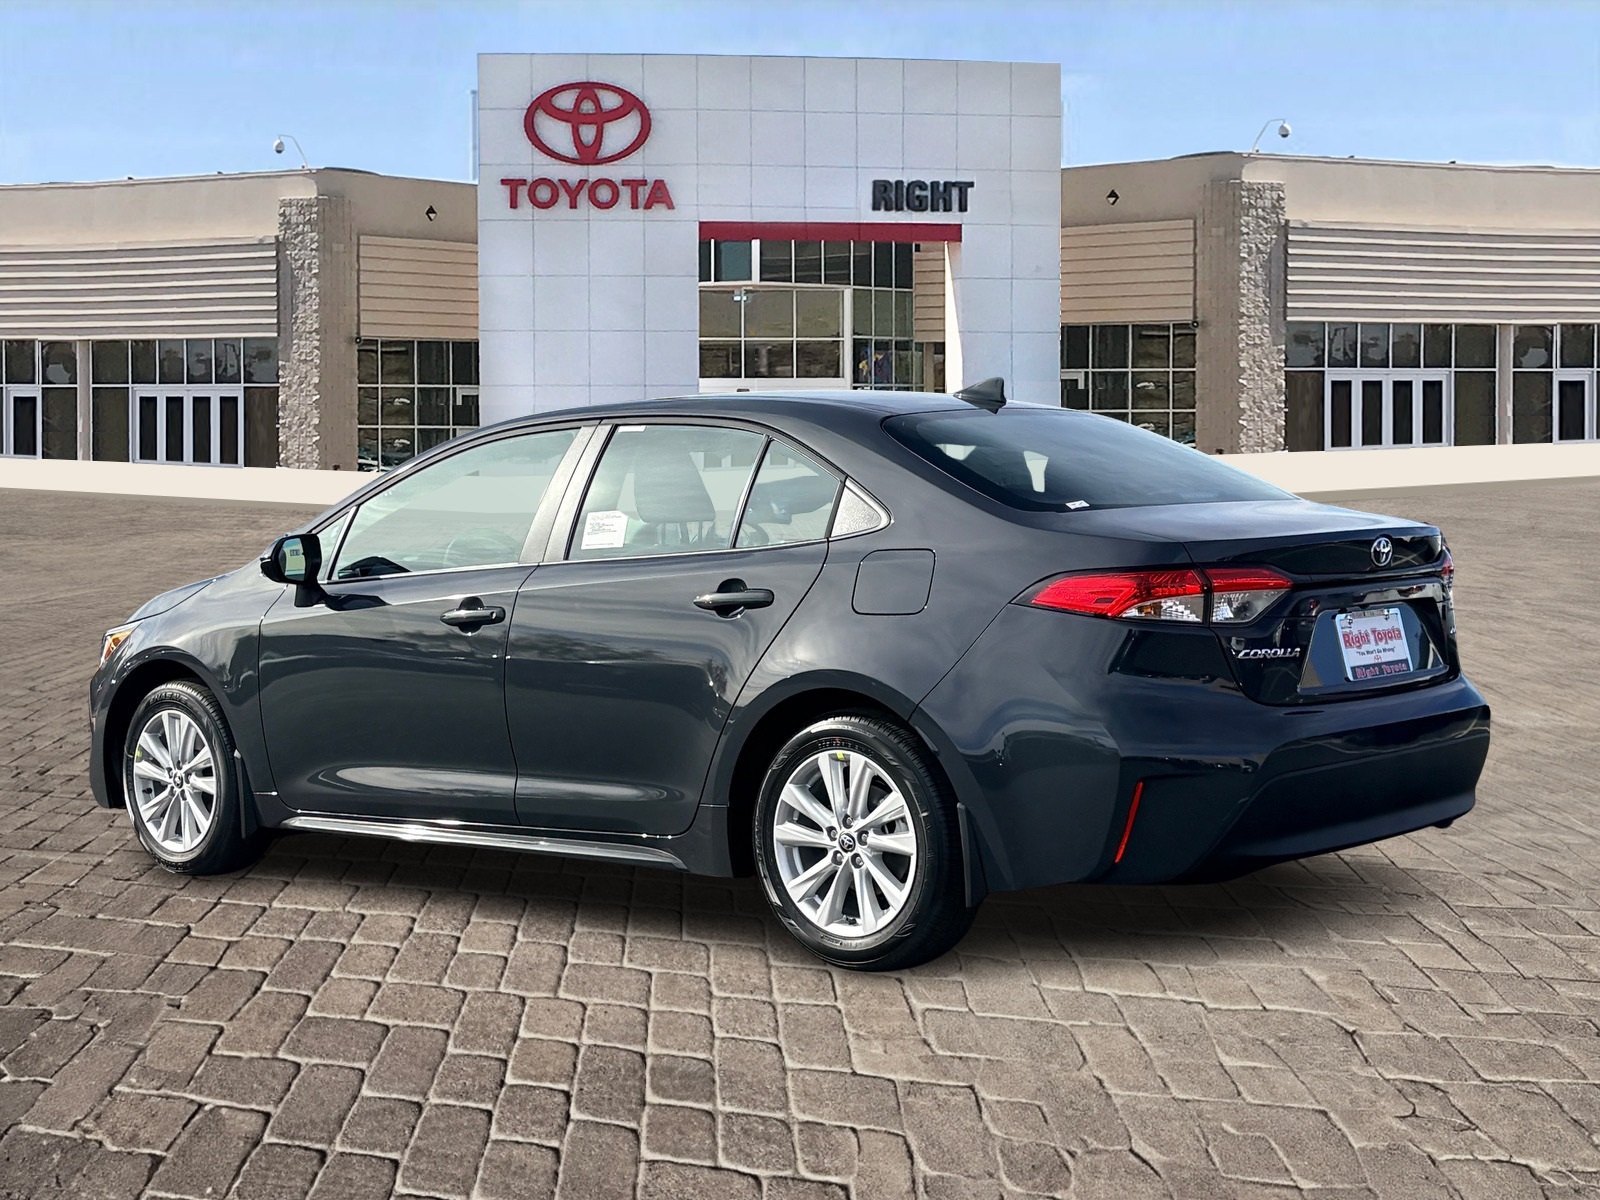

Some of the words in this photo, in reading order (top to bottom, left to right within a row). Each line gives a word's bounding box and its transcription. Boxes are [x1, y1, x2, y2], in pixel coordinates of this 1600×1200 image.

[500, 177, 675, 210] TOYOTA
[872, 180, 975, 212] RIGHT
[1342, 629, 1371, 649] Right
[1371, 626, 1402, 646] Toyota
[1237, 648, 1301, 659] COROLLA
[1355, 667, 1379, 679] Right
[1381, 663, 1408, 676] Toyota
